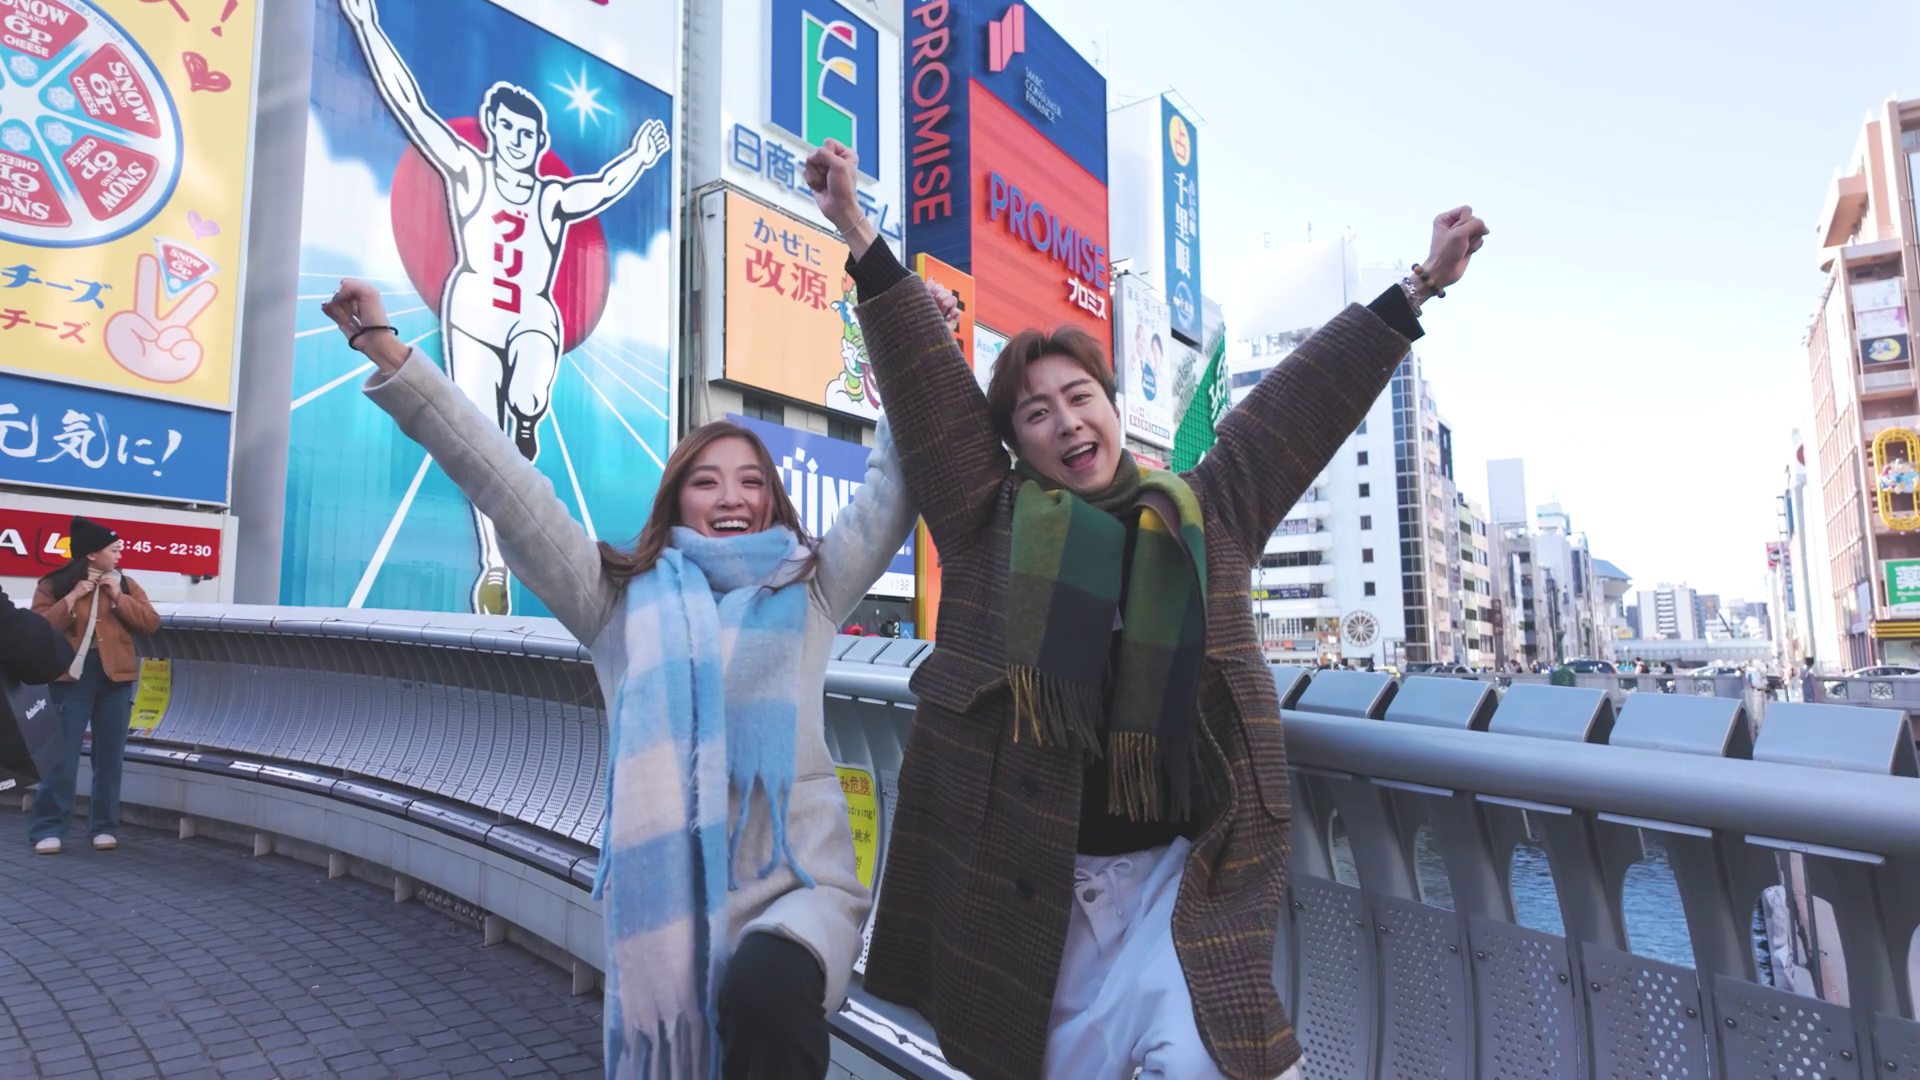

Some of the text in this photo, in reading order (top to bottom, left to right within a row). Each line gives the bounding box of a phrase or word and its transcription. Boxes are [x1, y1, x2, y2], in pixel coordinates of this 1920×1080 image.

[4, 15, 53, 45] 6P
[15, 9, 48, 26] BRAND
[4, 34, 50, 58] CHEESE
[73, 76, 100, 116] CHEESE
[89, 73, 116, 116] 6P
[107, 61, 155, 124] SNOW
[109, 80, 128, 108] BRAND
[1026, 90, 1055, 124] FINANCE
[912, 0, 951, 225] PROMISE
[0, 153, 39, 172] CHEES
[66, 138, 98, 168] CHEESE
[81, 151, 118, 180] 6P
[0, 185, 29, 199] BRAN
[98, 161, 147, 212] SNOW
[100, 166, 122, 187] BRAND
[734, 122, 902, 241] 日商テム
[0, 192, 50, 220] SNO
[754, 217, 821, 266] かぜに
[990, 171, 1106, 289] PROMISE
[169, 248, 204, 269] SNOW
[491, 209, 529, 314] グリコ
[1, 264, 113, 309] チーズ
[744, 243, 828, 311] 改源
[1067, 277, 1107, 320] プロミス
[0, 308, 91, 344] チーズ
